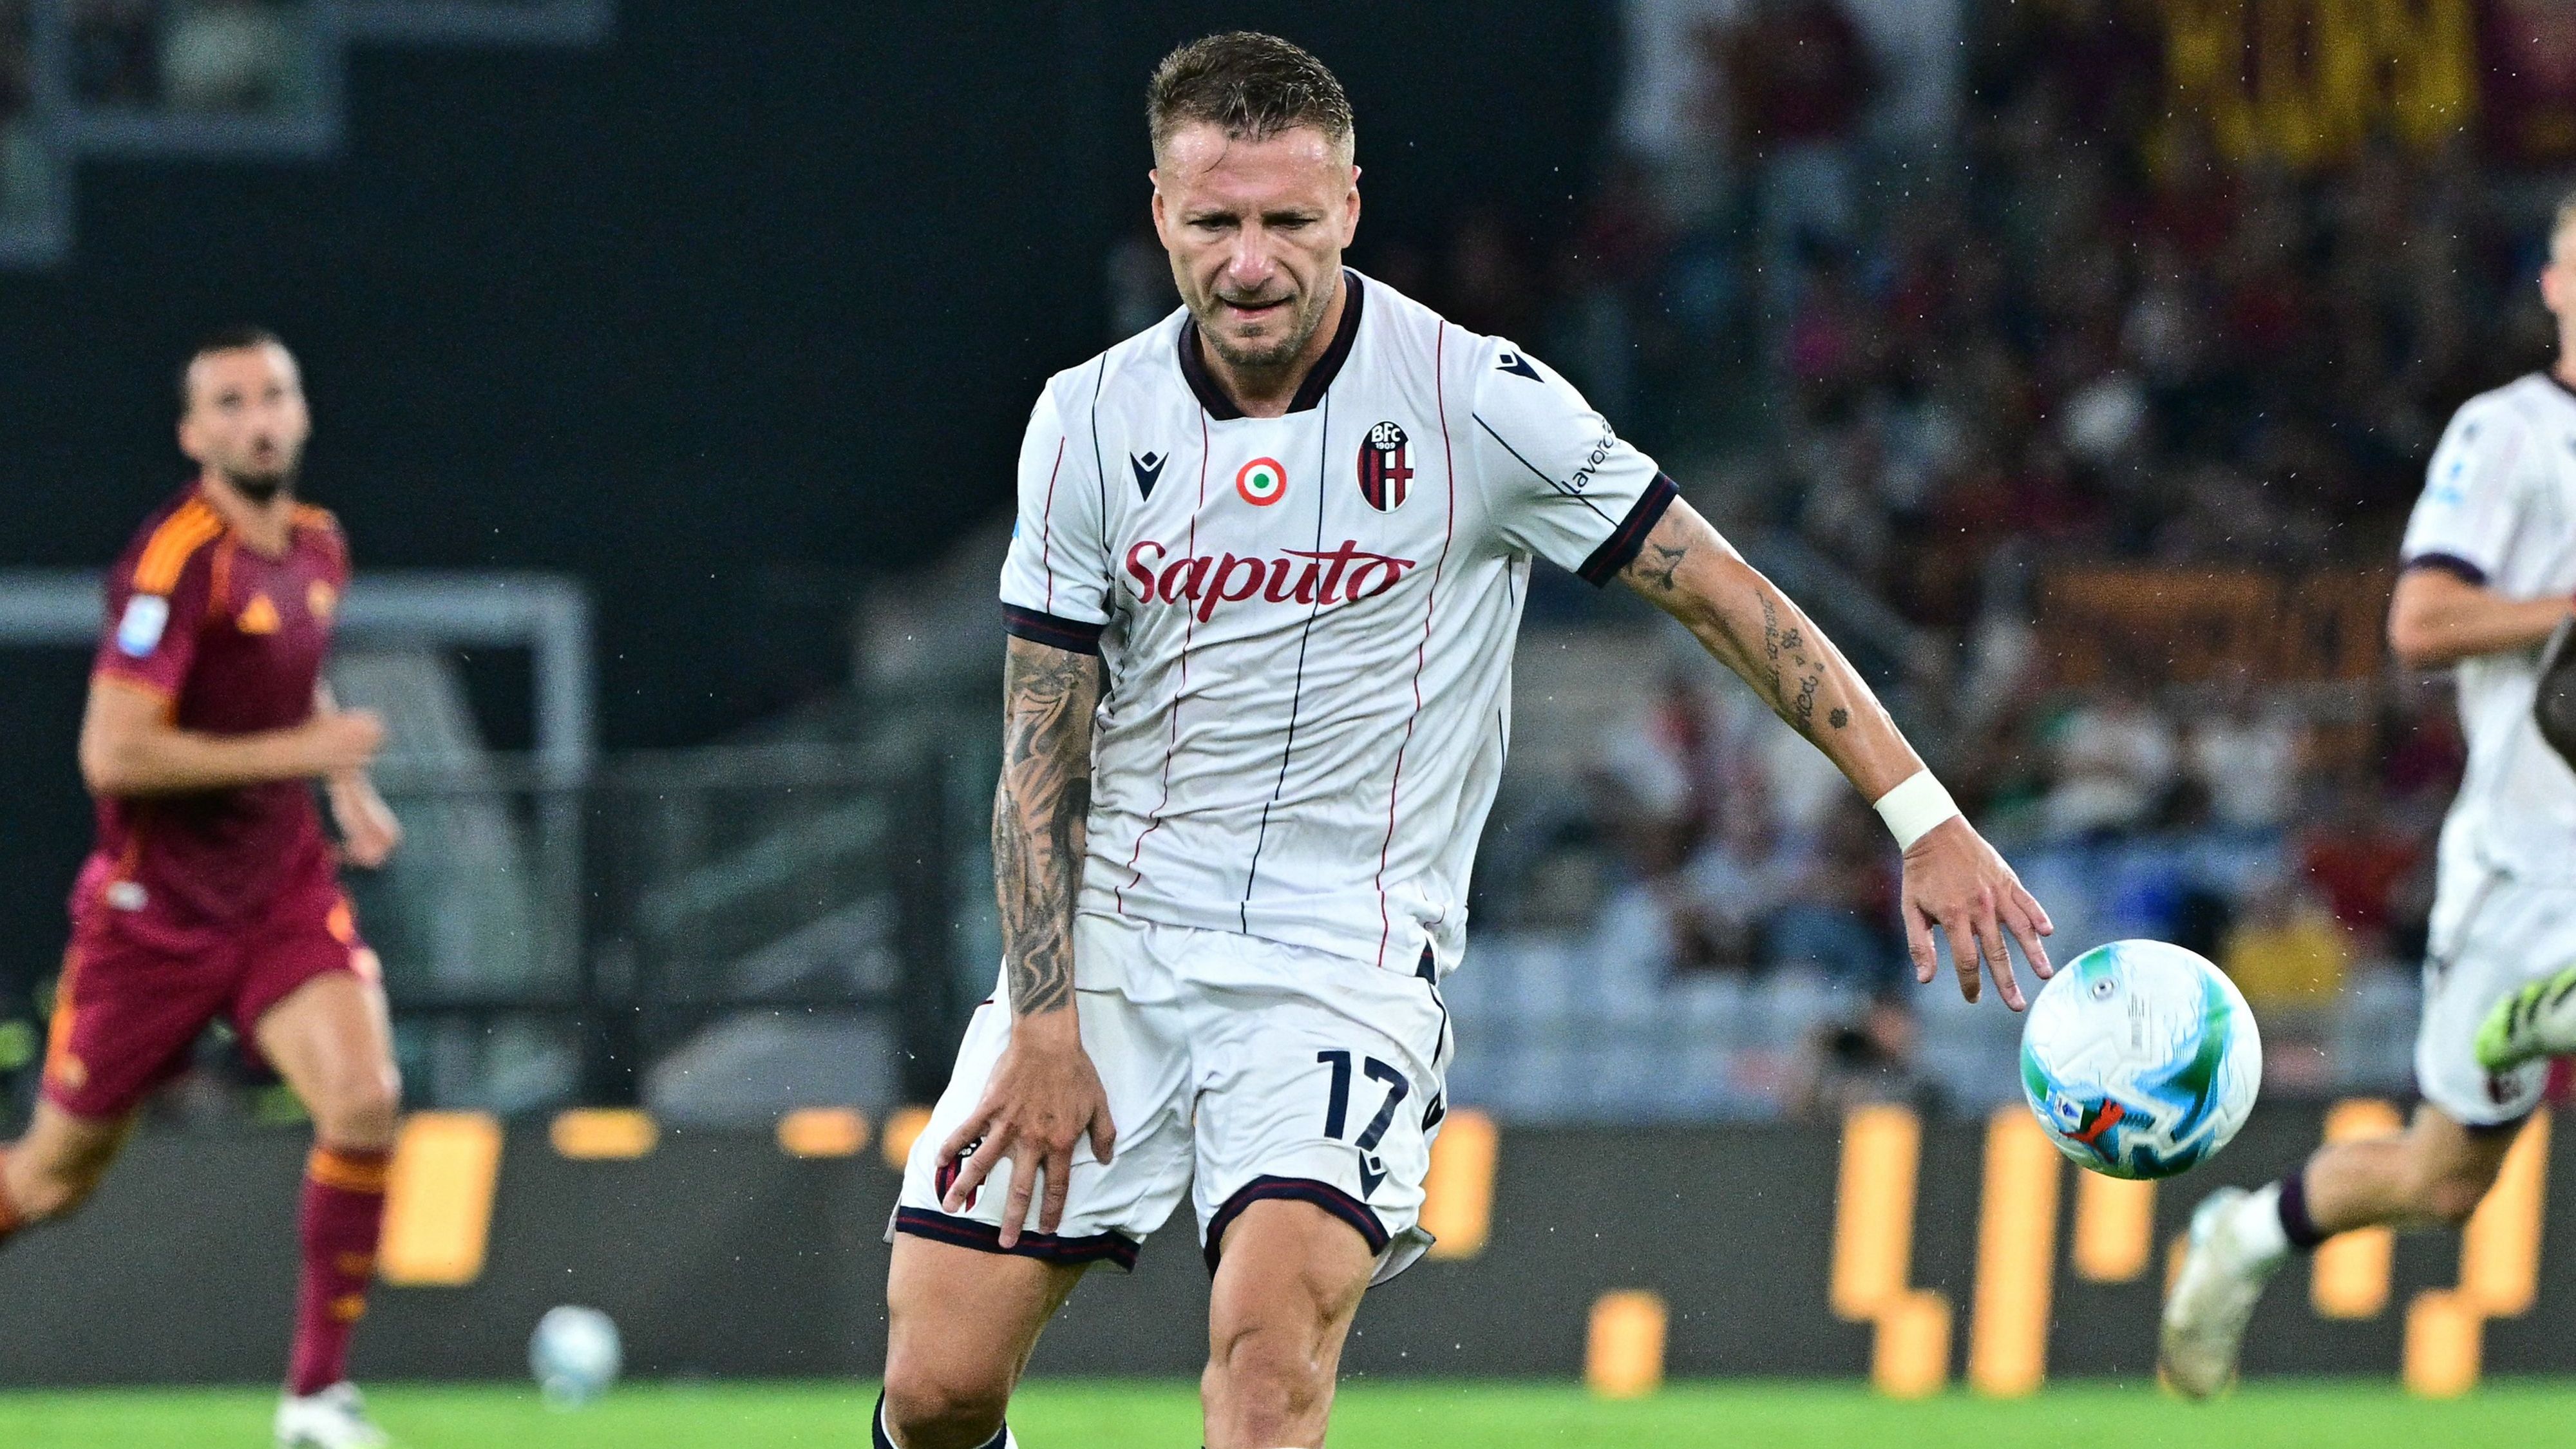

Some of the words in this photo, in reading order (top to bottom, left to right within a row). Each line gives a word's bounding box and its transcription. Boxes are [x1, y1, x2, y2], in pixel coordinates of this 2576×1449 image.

[1371, 422, 1401, 442] BFC
[1126, 540, 1416, 623] Saputo
[1317, 1050, 1409, 1152] 17
